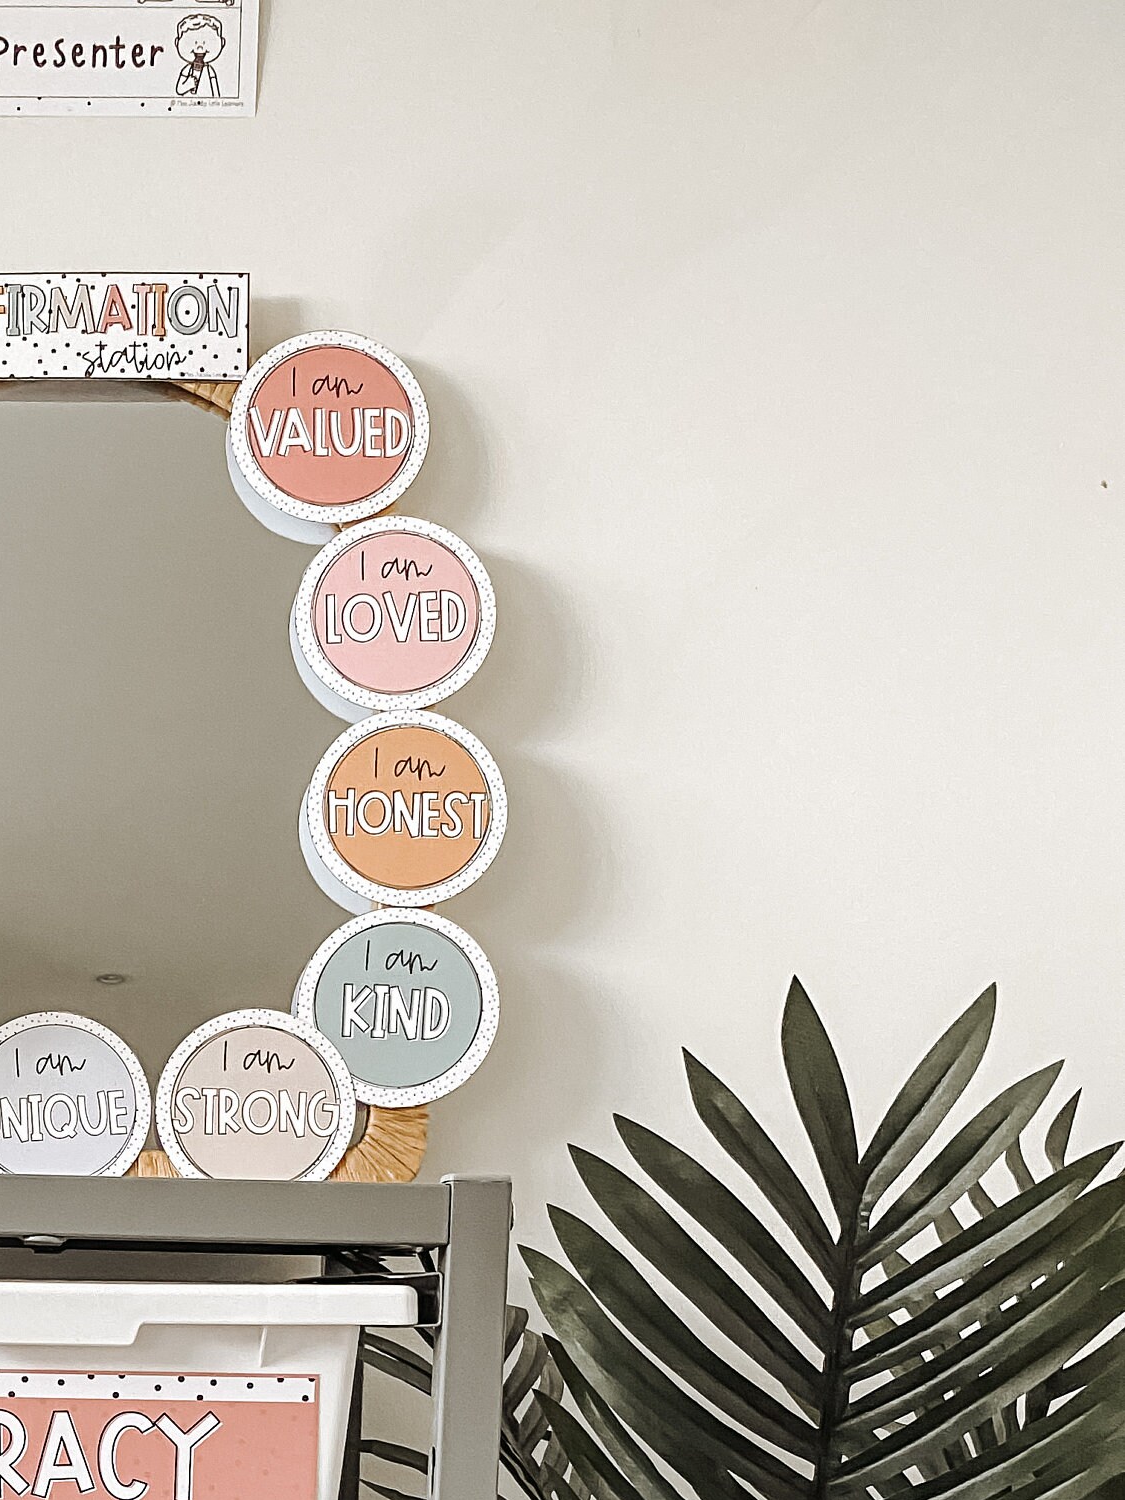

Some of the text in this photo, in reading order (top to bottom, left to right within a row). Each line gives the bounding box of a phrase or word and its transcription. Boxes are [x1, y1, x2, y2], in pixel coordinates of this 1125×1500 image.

[82, 341, 187, 377] station
[292, 366, 364, 398] I am
[247, 406, 412, 458] VALUED
[361, 551, 433, 581] I am
[325, 590, 467, 644] LOVED
[374, 747, 446, 781] I am
[327, 788, 488, 840] HONEST
[364, 940, 438, 975] I am
[341, 983, 450, 1042] KIND
[15, 1048, 86, 1078] I am
[223, 1040, 295, 1074] I am
[173, 1086, 341, 1139] STRONG
